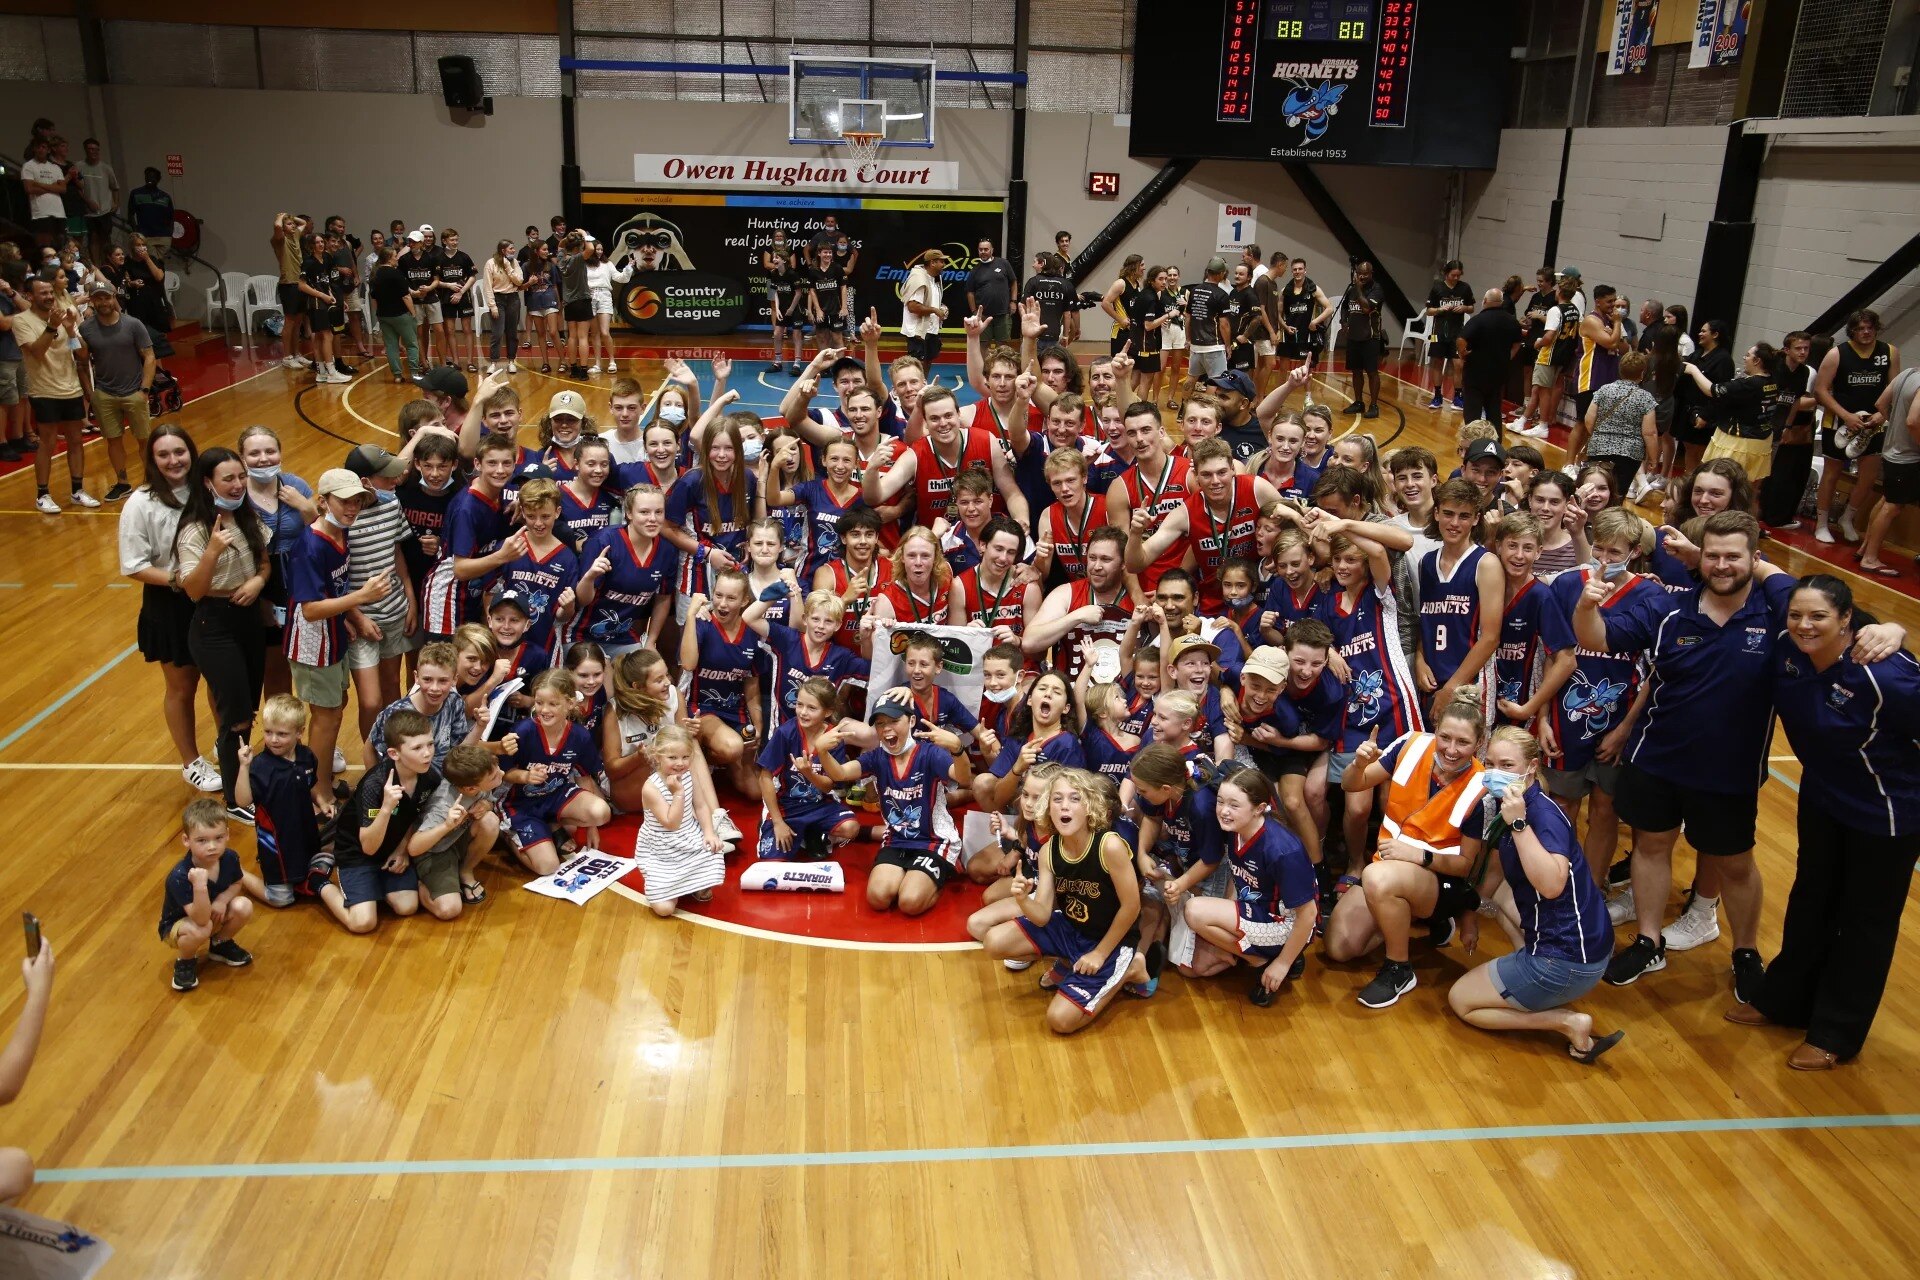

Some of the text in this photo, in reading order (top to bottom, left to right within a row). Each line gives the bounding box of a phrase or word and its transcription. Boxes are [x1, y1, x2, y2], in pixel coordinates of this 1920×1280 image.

[1236, 1, 1243, 10] 5
[1345, 5, 1368, 13] DARK
[1386, 3, 1412, 12] 32 2
[1246, 14, 1254, 24] 2
[1385, 16, 1410, 26] 33 2
[1234, 28, 1241, 37] 8
[1278, 20, 1302, 38] 88
[1339, 21, 1364, 39] 80
[1384, 30, 1397, 39] 39
[1230, 40, 1240, 49] 10
[1382, 43, 1408, 52] 40 4
[1714, 33, 1738, 51] 200
[1229, 53, 1251, 62] 12 5
[1628, 44, 1647, 63] 300
[1321, 58, 1358, 66] HORSHAM
[1381, 57, 1406, 66] 41 3
[1228, 66, 1250, 75] 13 2
[1272, 62, 1359, 79] HORNETS
[1380, 69, 1393, 79] 42
[1227, 79, 1238, 87] 14
[1378, 83, 1392, 91] 47
[1223, 91, 1237, 100] 23
[1377, 96, 1391, 104] 49
[1223, 104, 1247, 113] 30 2
[1375, 109, 1389, 118] 50
[1270, 148, 1347, 158] Established 1953
[663, 158, 931, 187] Owen Hughan Court
[1092, 175, 1116, 192] 24
[1225, 205, 1252, 216] Court
[747, 218, 799, 233] Hunting
[1232, 220, 1242, 241] 1
[725, 235, 749, 247] real
[749, 253, 758, 265] is
[664, 286, 726, 298] Country
[665, 295, 743, 307] Basketball
[666, 308, 721, 320] League
[1874, 354, 1888, 366] 32
[1847, 373, 1882, 384] COASTERS
[567, 517, 609, 529] HORNETS
[511, 570, 559, 589] HORNETS
[1420, 601, 1471, 615] HORNETS
[1435, 624, 1447, 651] 9
[1340, 637, 1376, 657] RNETS
[1099, 763, 1130, 774] HORN
[557, 854, 590, 876] HORNETS
[577, 858, 612, 876] GO
[912, 856, 940, 879] FILA
[783, 872, 833, 884] HORNETS
